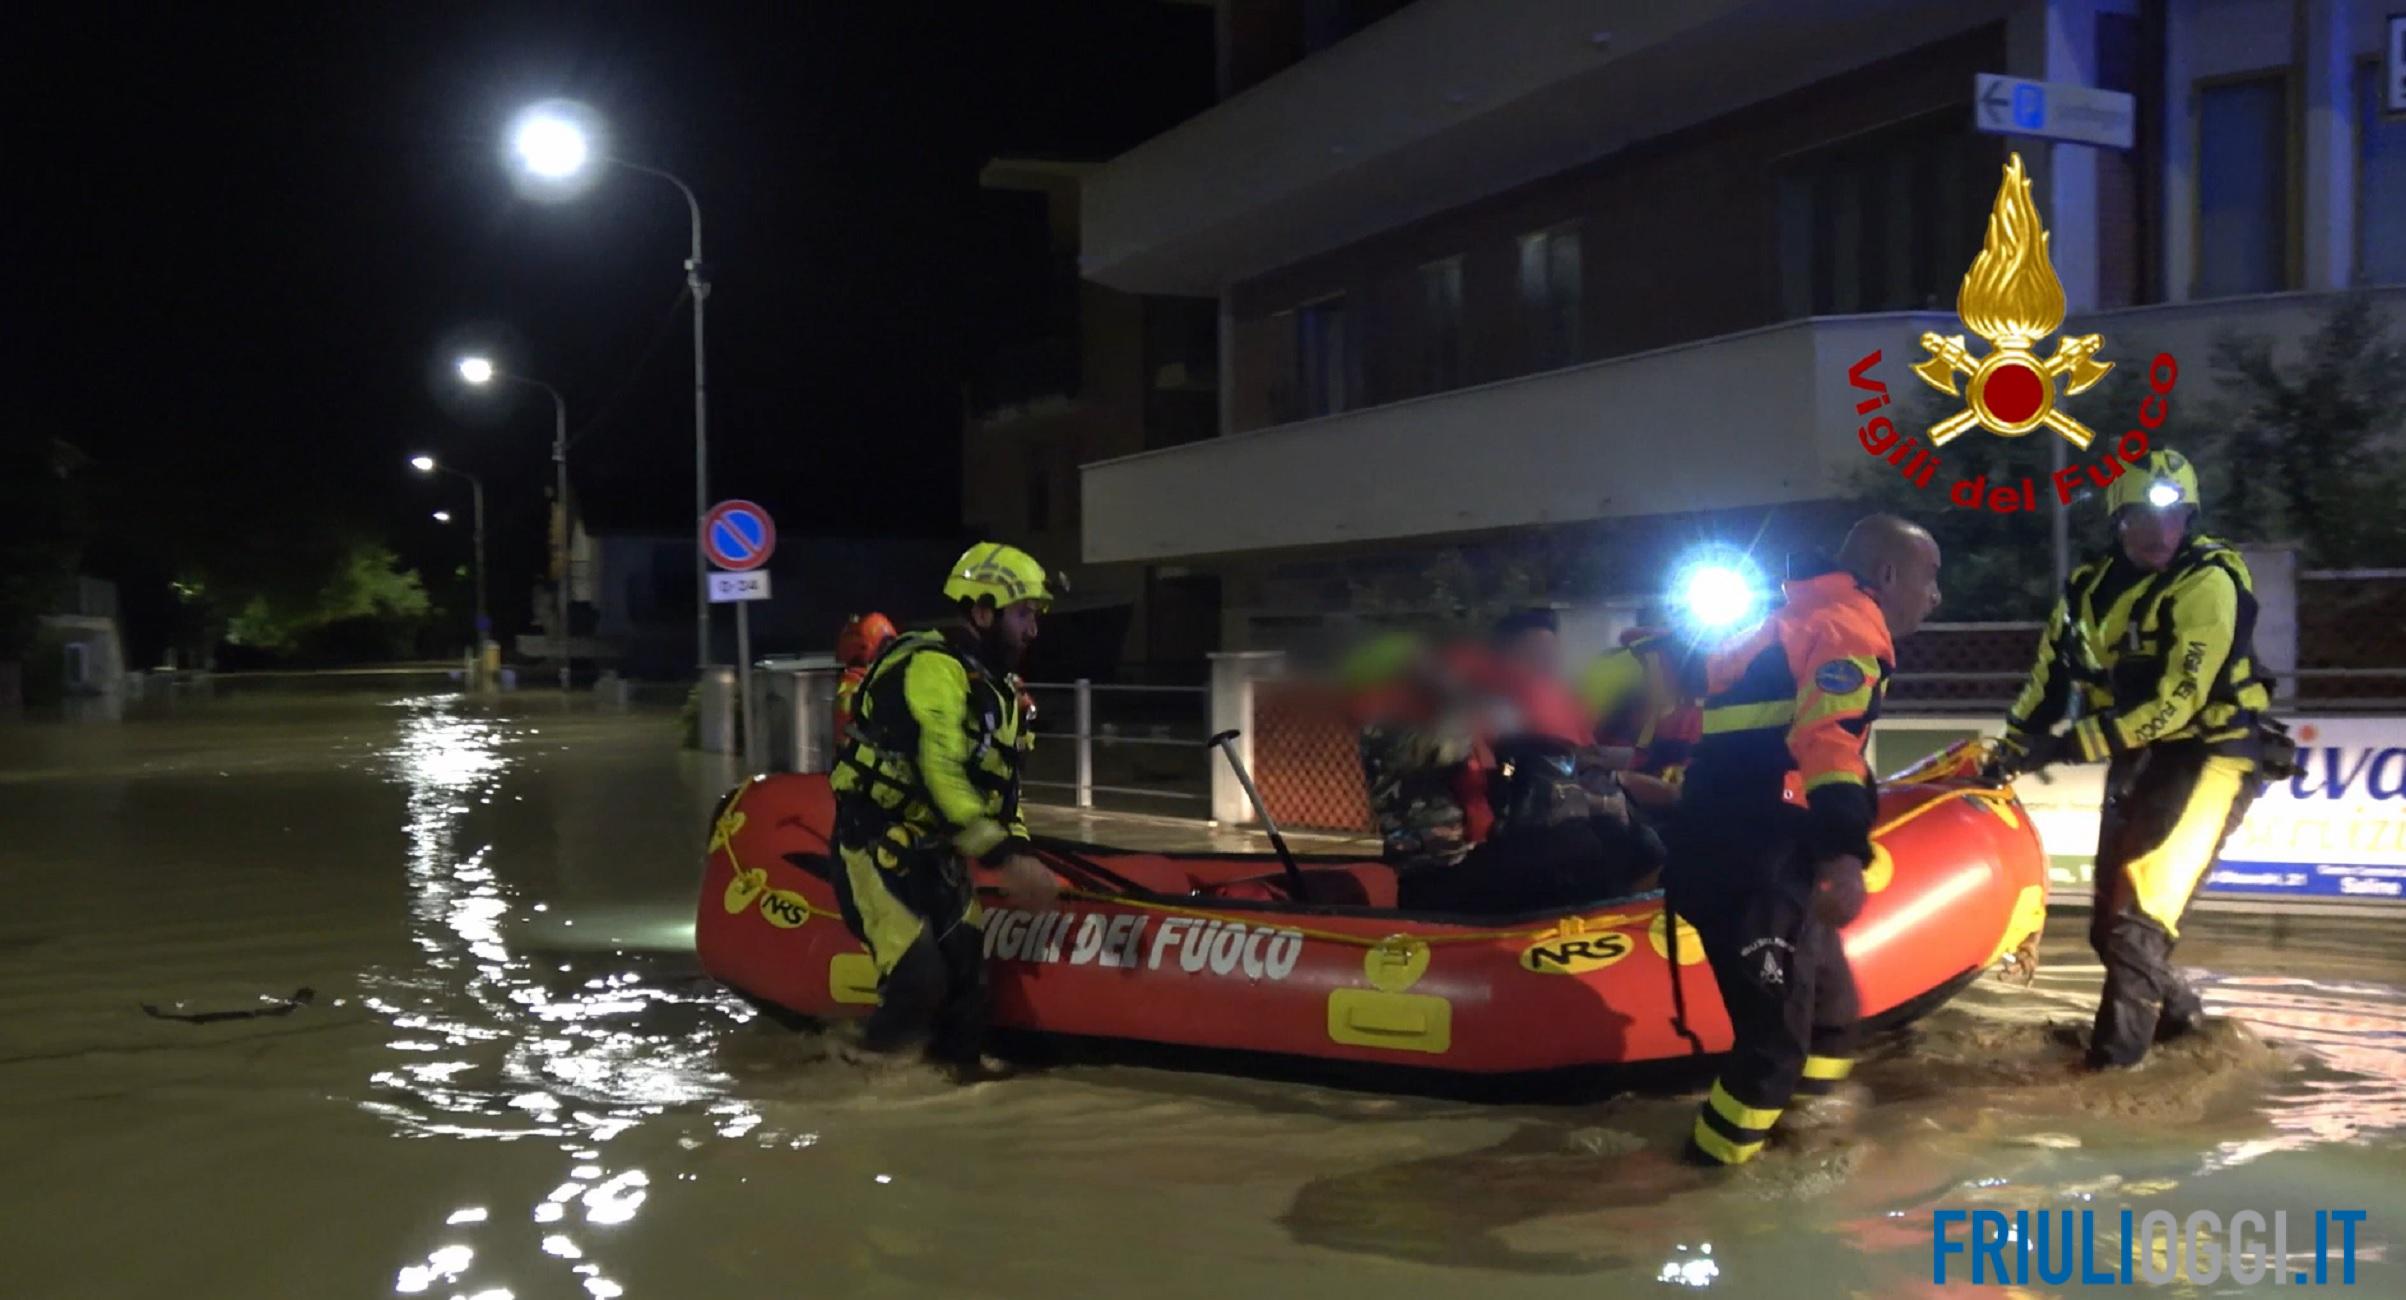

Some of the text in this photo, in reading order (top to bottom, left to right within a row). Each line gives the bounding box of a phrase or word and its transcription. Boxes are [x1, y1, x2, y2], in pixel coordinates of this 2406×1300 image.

[2258, 724, 2406, 801] iva
[762, 893, 808, 925] NRS
[1069, 912, 1150, 969] DEL
[1148, 916, 1305, 981] FUOCO
[1530, 934, 1627, 970] NRS
